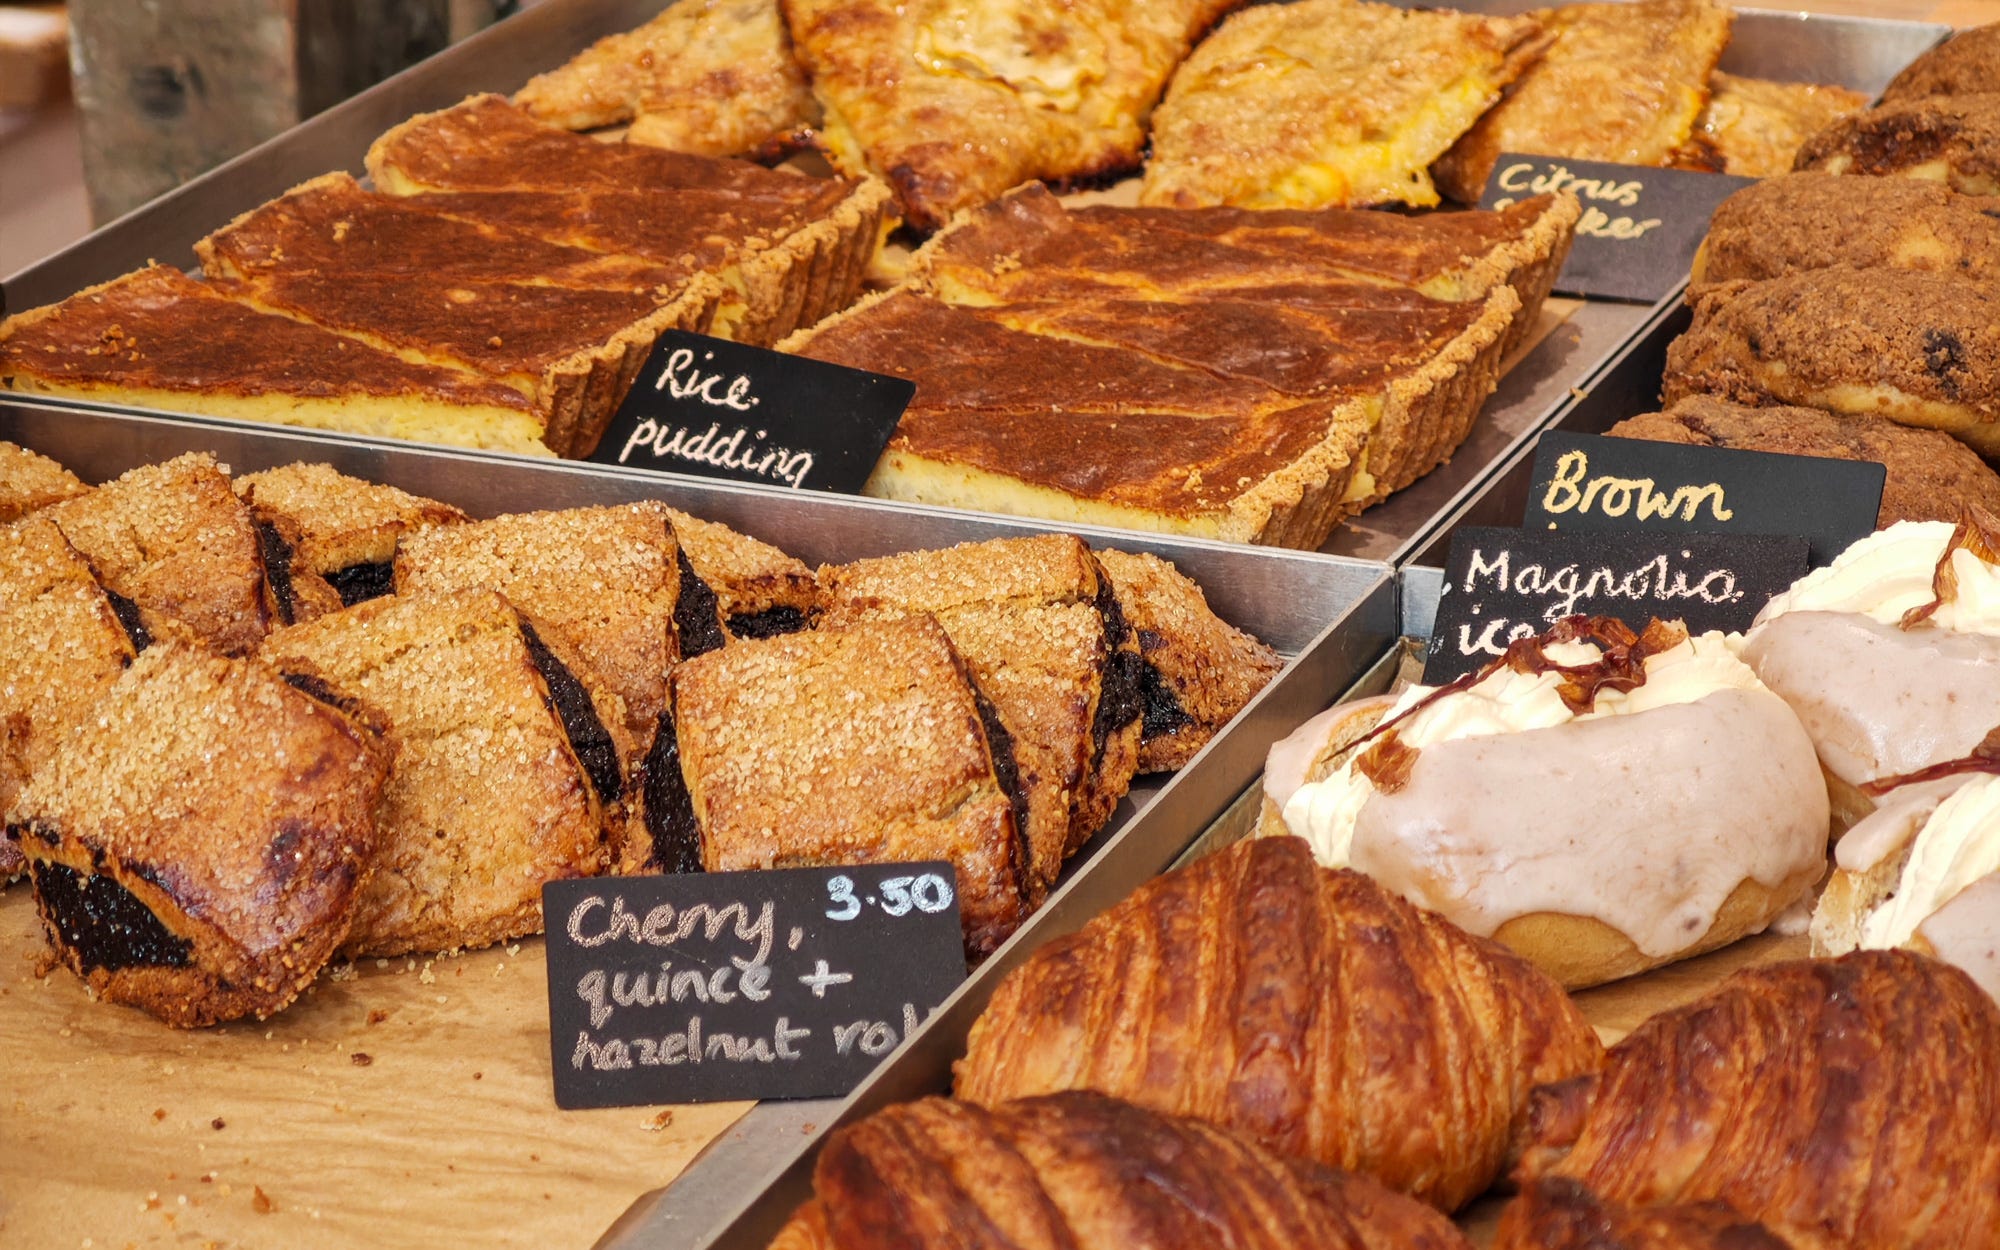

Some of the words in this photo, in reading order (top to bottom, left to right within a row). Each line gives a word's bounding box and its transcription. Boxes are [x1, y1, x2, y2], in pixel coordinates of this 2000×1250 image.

[1498, 163, 1643, 206] Citrus
[655, 348, 760, 411] Rice
[618, 416, 814, 488] pudding
[1543, 450, 1733, 521] Brown
[1463, 548, 1746, 624] Magnolia
[825, 874, 953, 921] 3.50
[576, 960, 773, 1029] quince
[799, 959, 853, 998] +
[571, 1015, 811, 1072] hazelnut
[832, 1002, 941, 1057] rol
